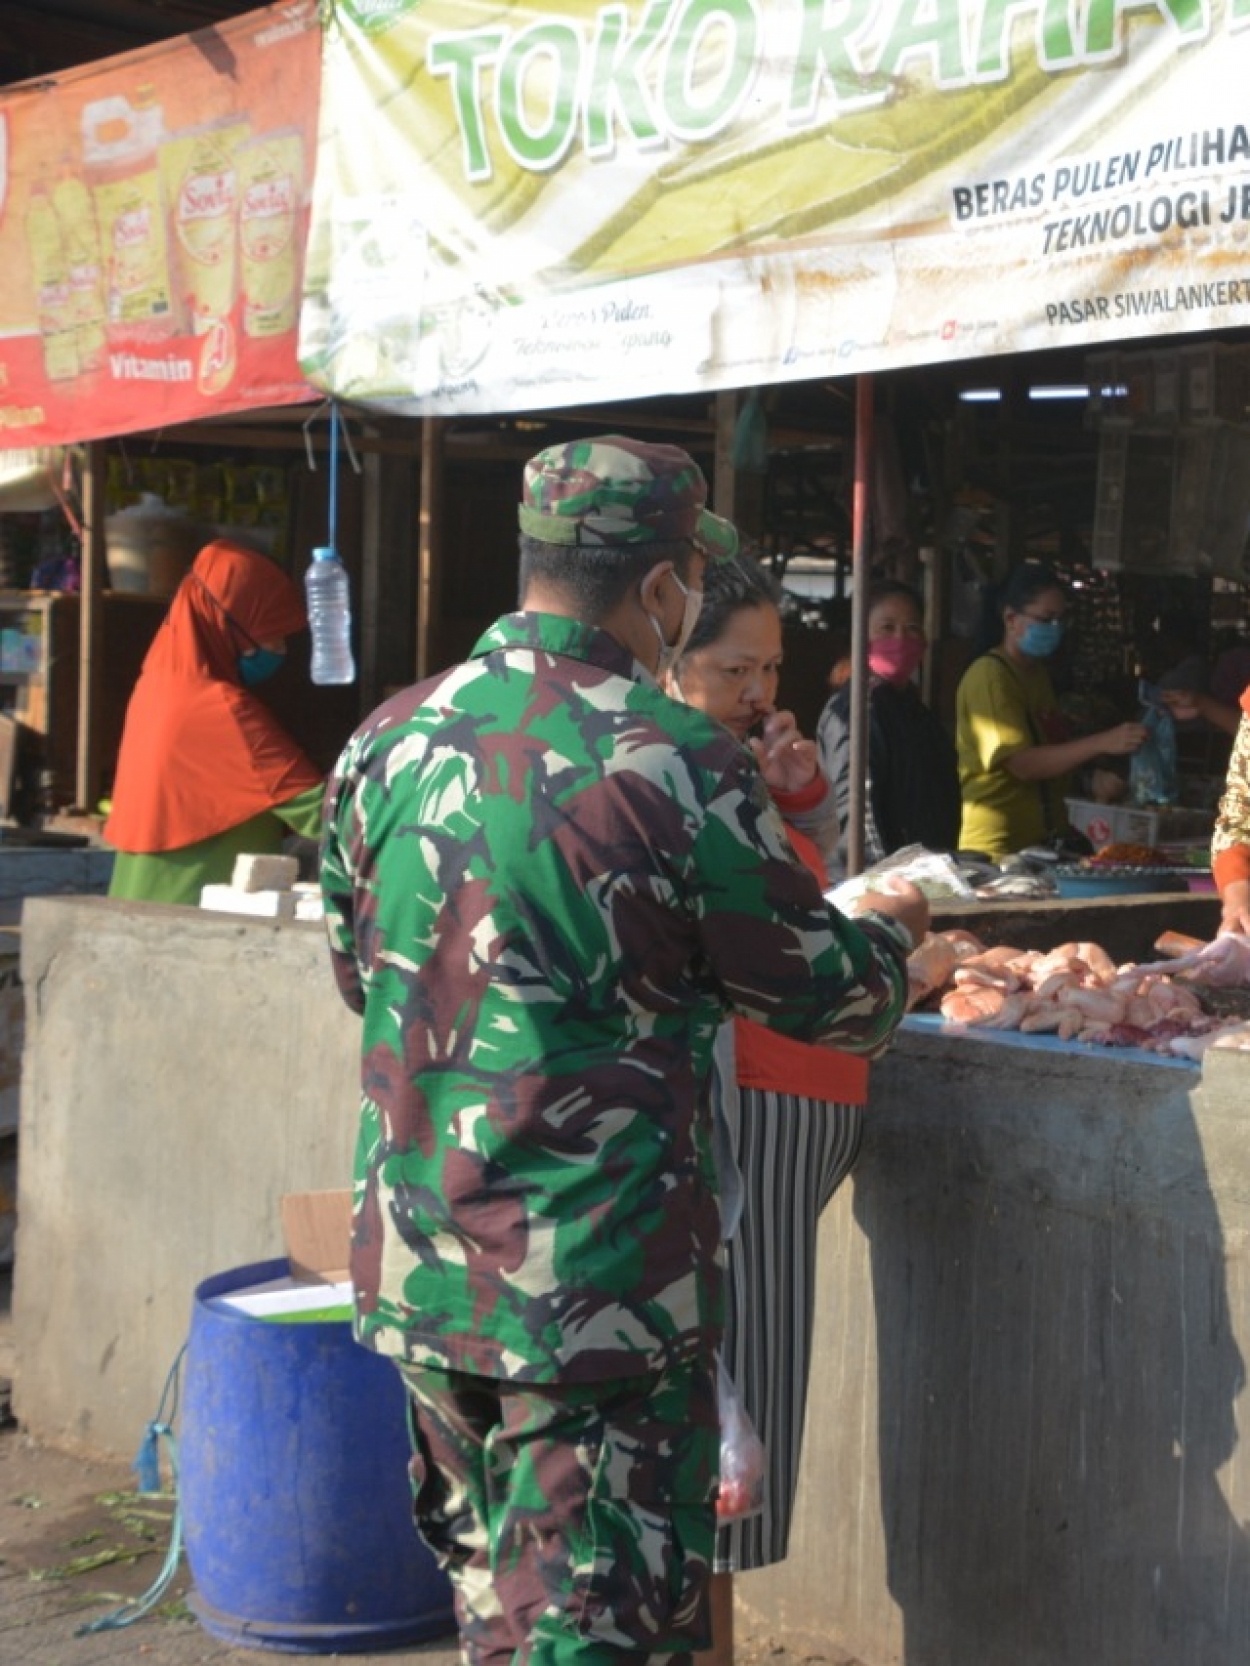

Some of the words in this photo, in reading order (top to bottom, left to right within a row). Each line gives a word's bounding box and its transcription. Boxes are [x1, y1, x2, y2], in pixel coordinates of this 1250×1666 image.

[430, 0, 758, 176] TOKO
[952, 172, 1046, 222] BERAS
[1052, 150, 1142, 202] PULEN
[1043, 190, 1211, 254] TEKNOLOGI
[1046, 296, 1111, 326] PASAR
[109, 353, 193, 381] Vitamin
